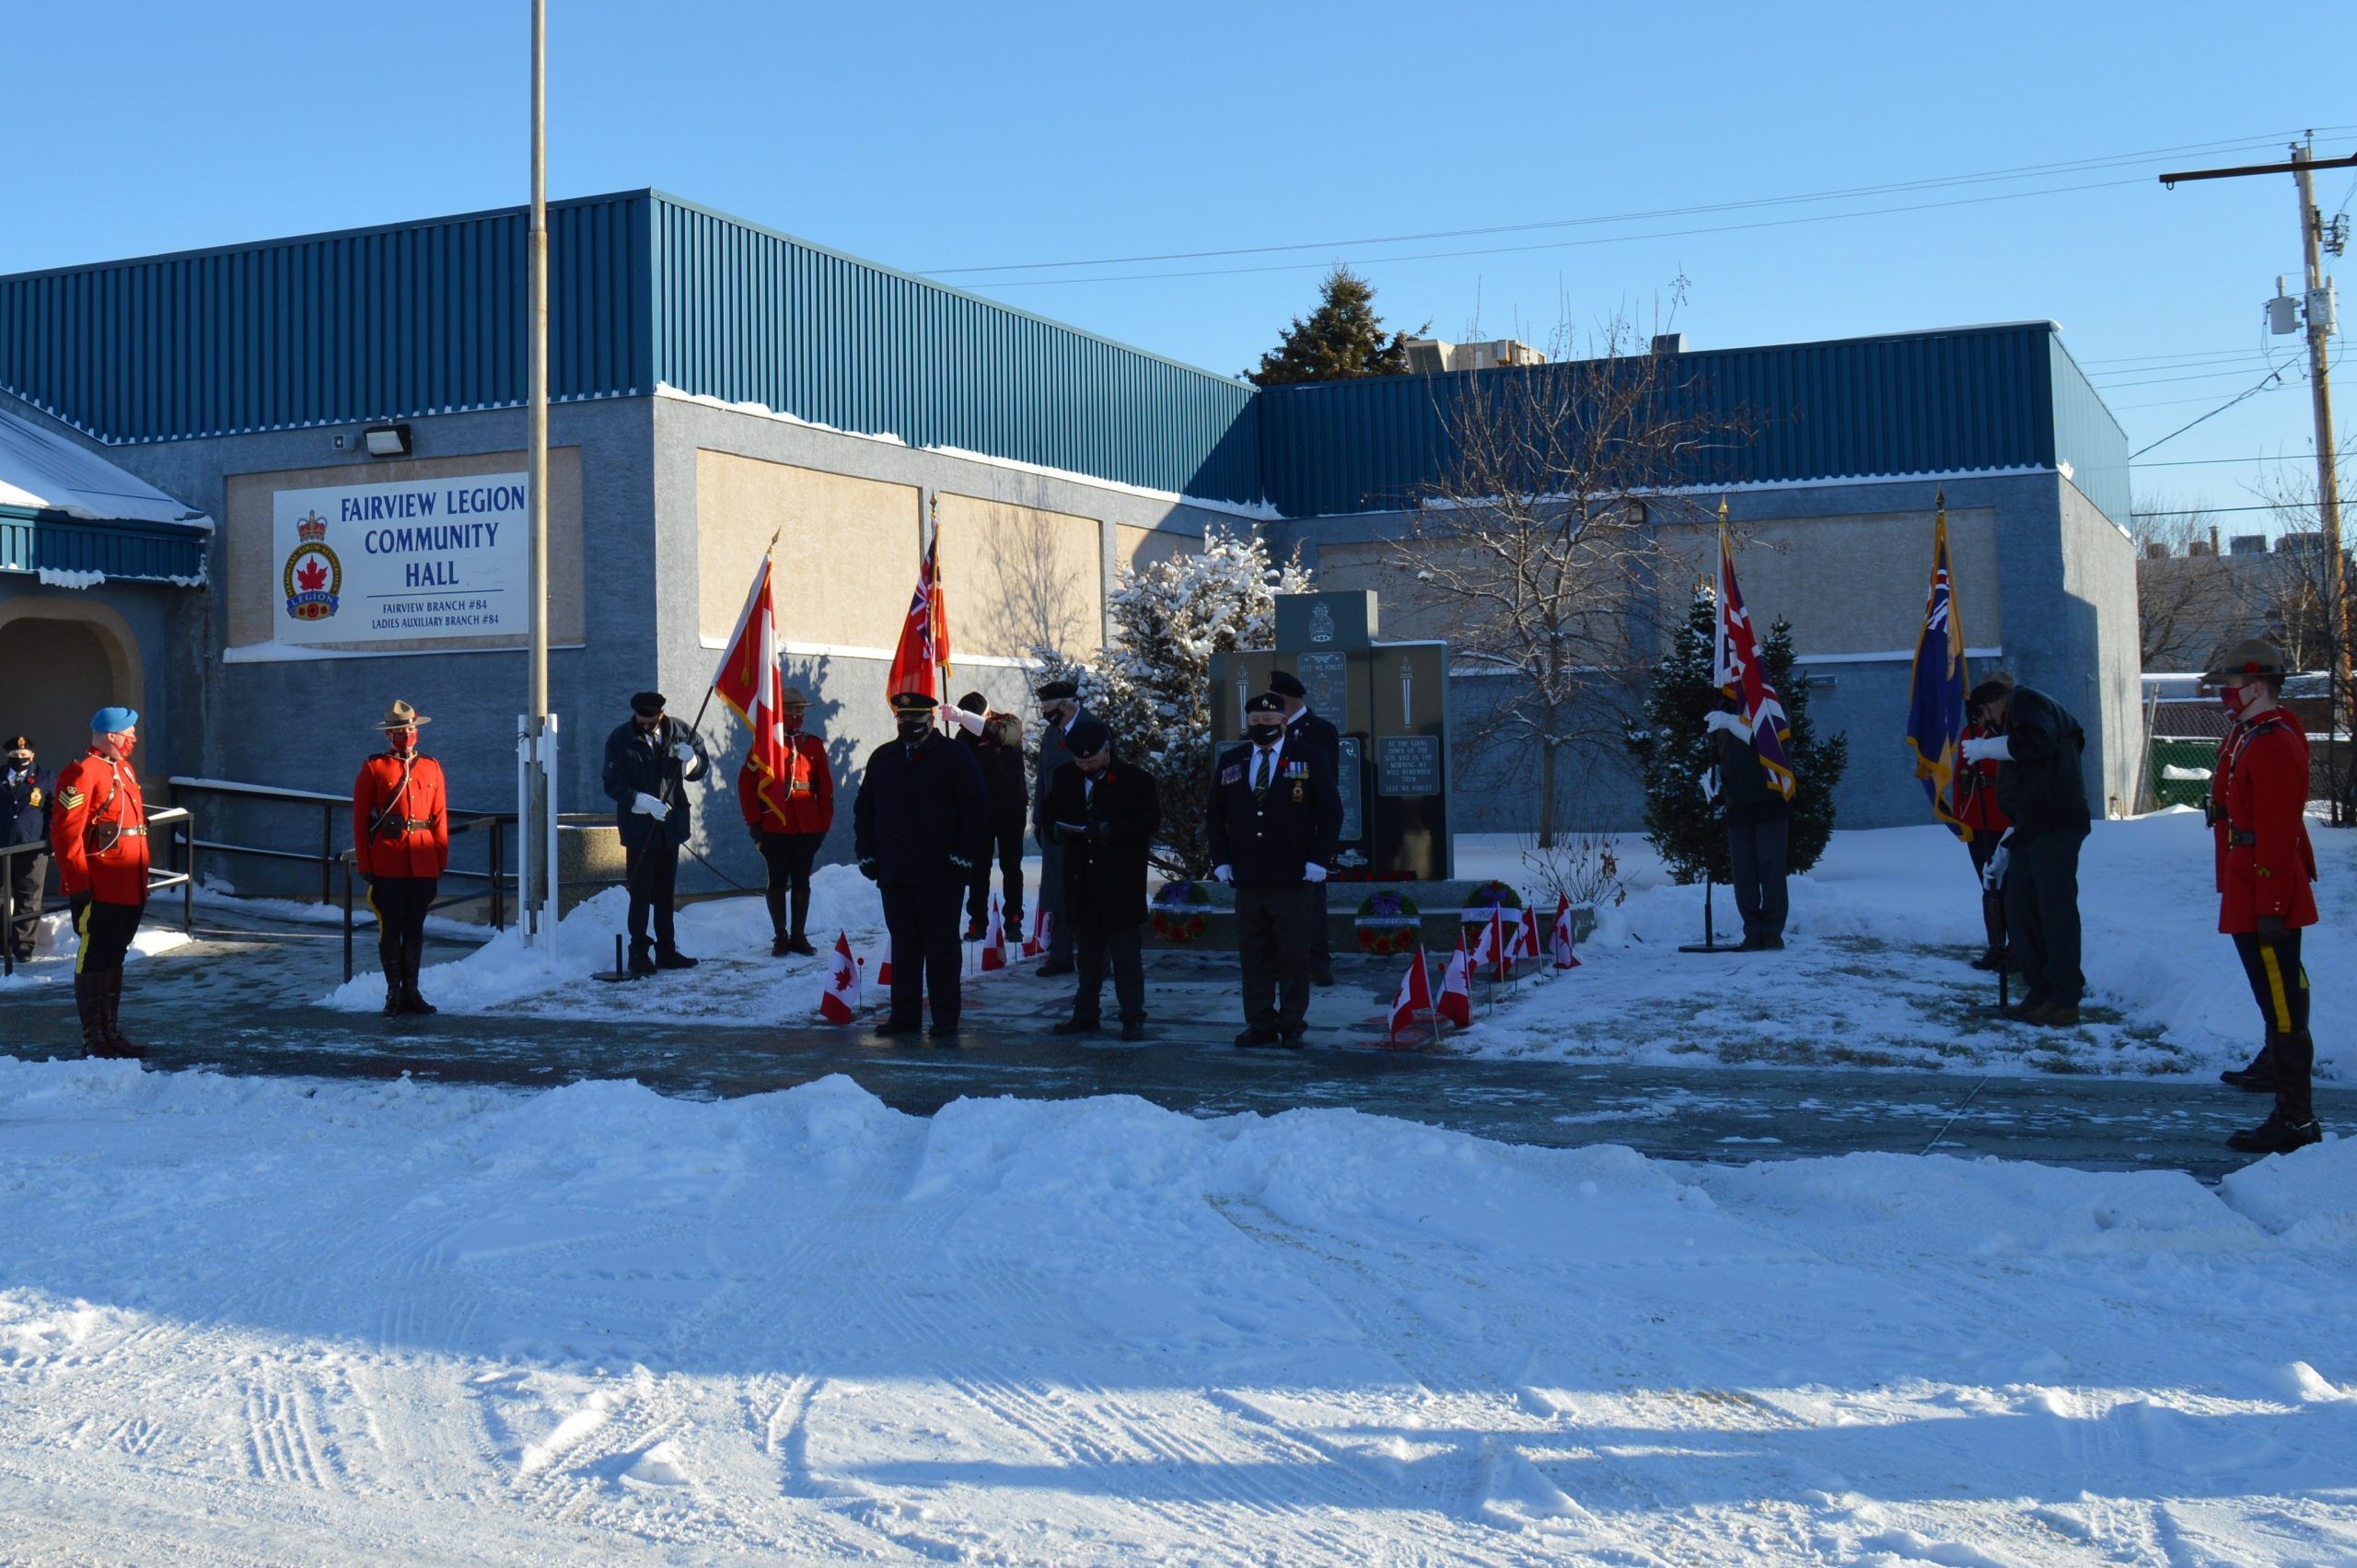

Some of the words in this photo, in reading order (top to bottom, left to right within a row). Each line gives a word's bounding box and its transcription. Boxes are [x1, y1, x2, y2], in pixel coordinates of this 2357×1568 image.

[341, 492, 436, 522] FAIRVIEW
[447, 485, 525, 516] LEGION
[365, 522, 499, 554] COMMUNITY
[405, 561, 459, 587] HALL
[290, 593, 333, 607] LEGION
[383, 602, 424, 614] FAIRVIEW
[426, 600, 466, 612] BRANCH
[469, 599, 487, 610] #84
[372, 618, 400, 629] LADIES
[401, 616, 443, 628] AUXILIARY
[445, 614, 480, 626] BRANCH
[482, 613, 499, 625] #84
